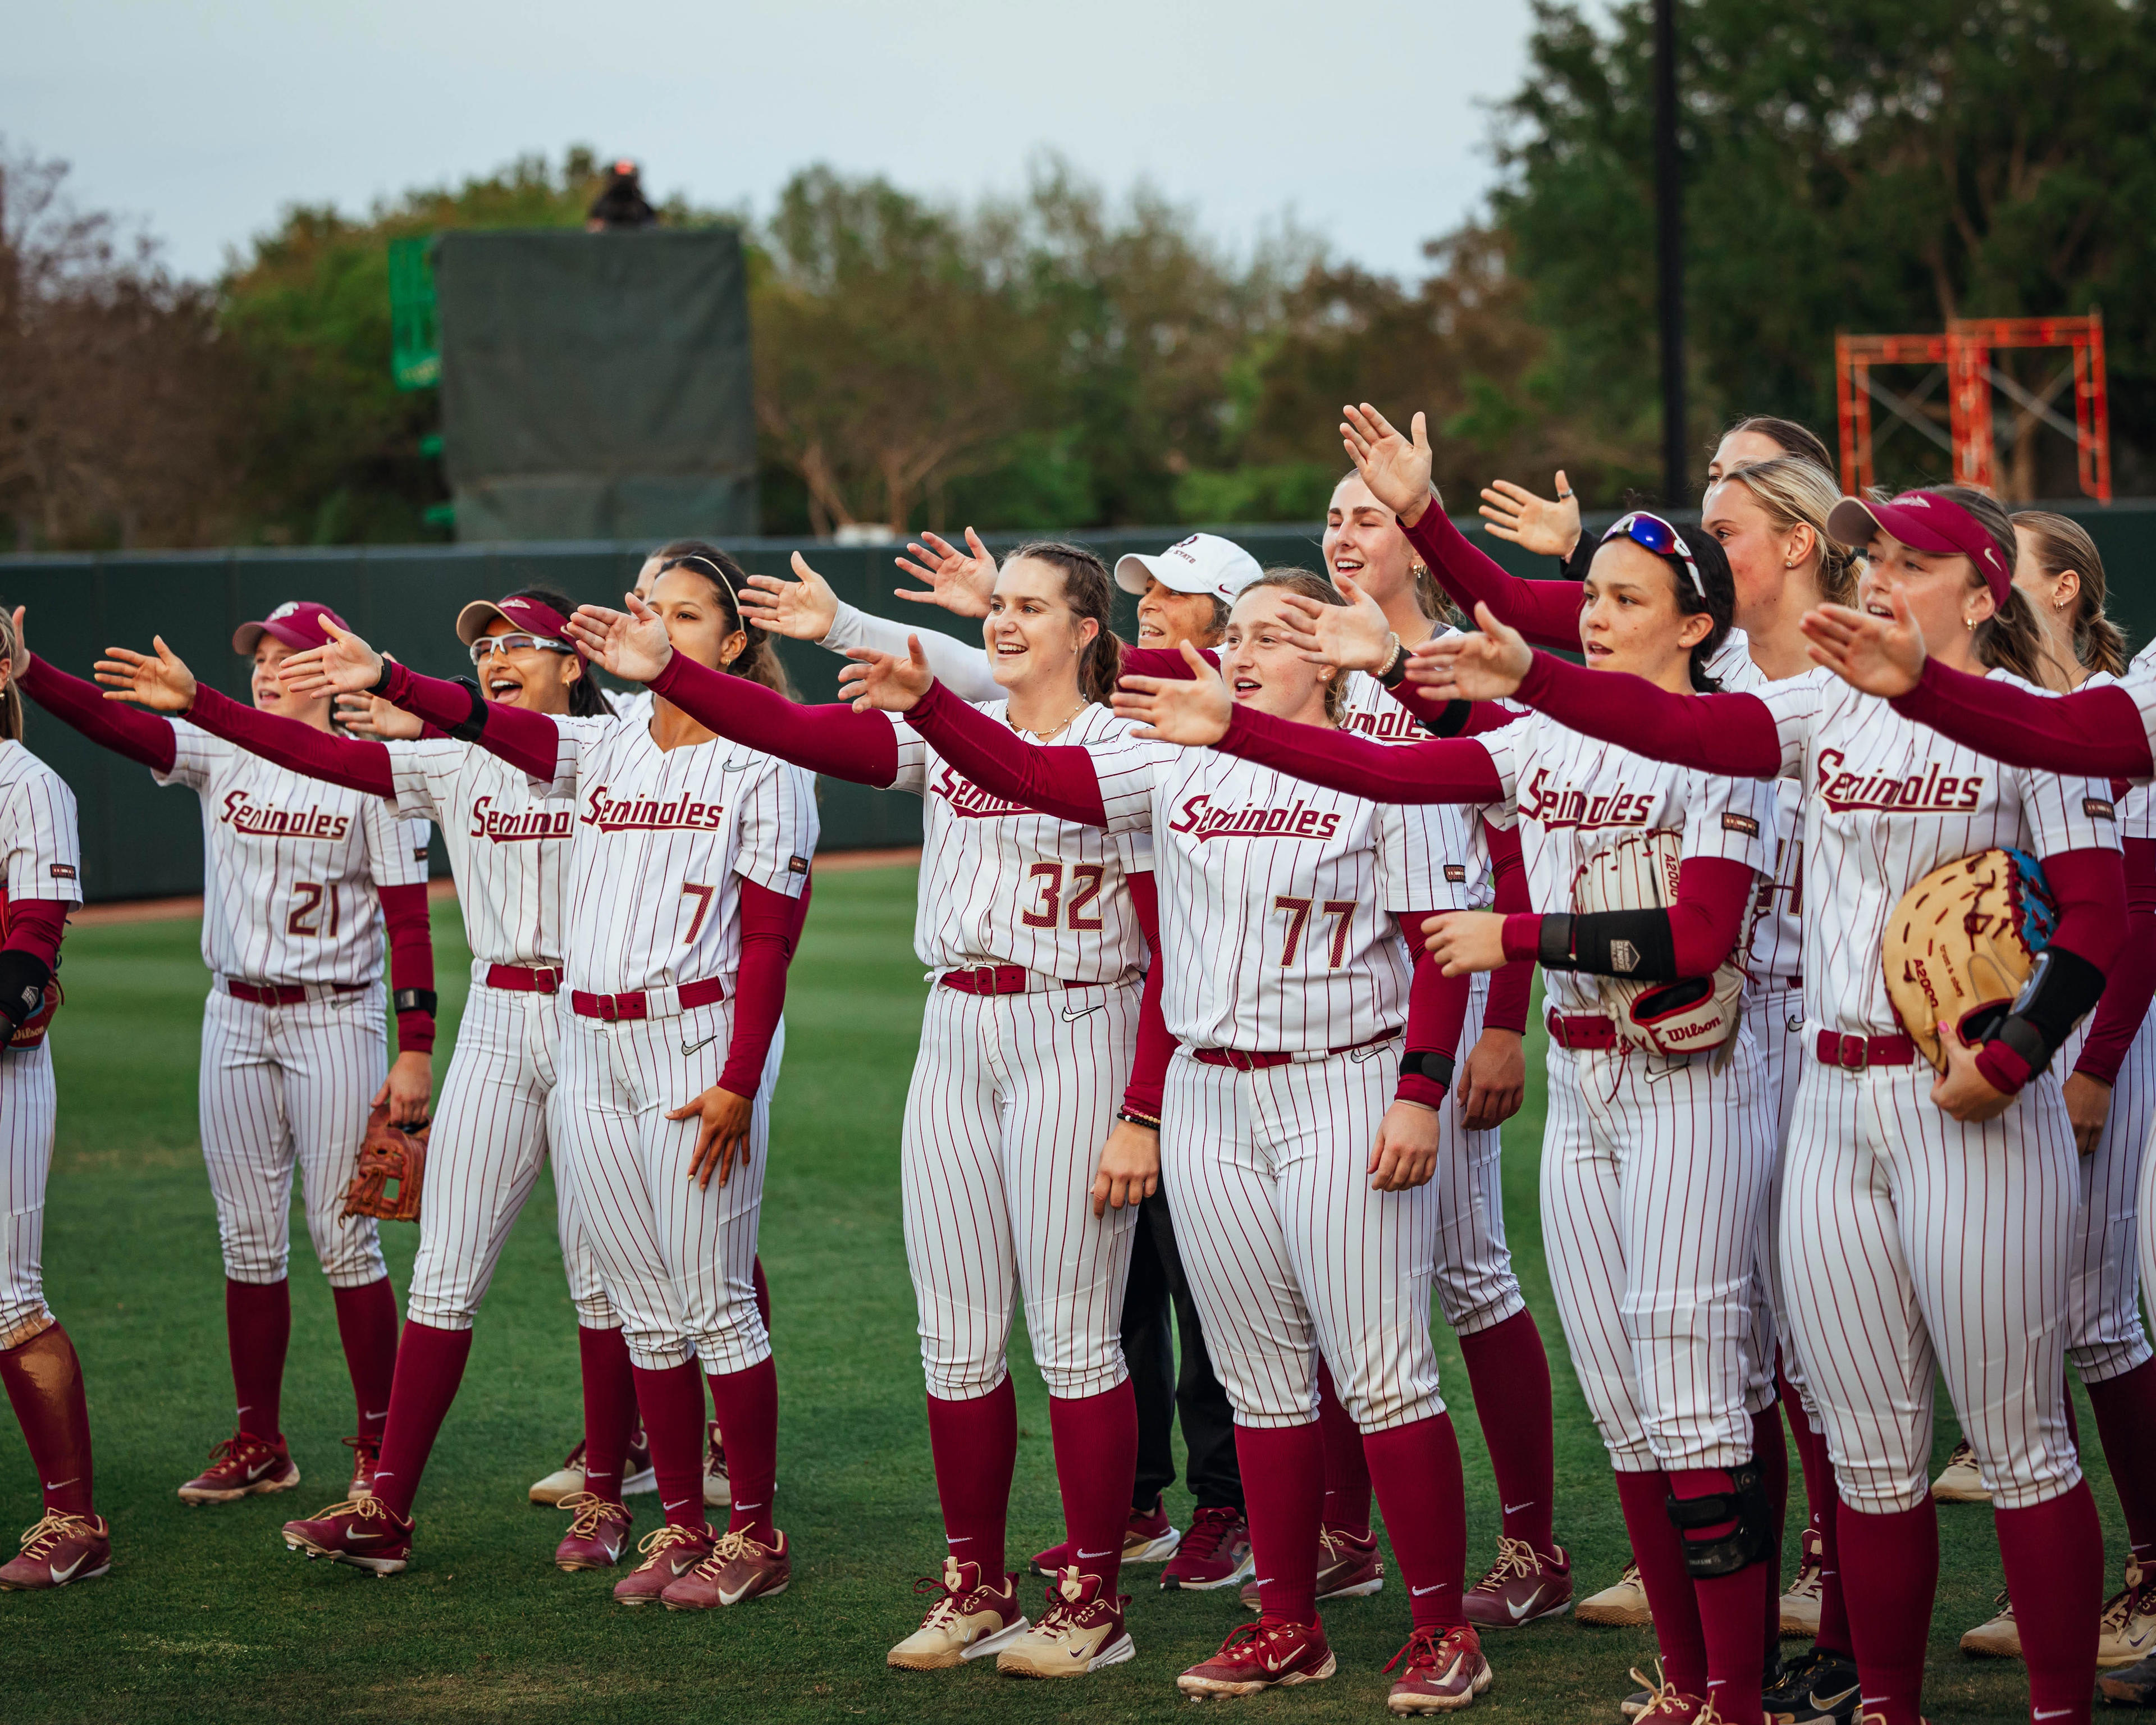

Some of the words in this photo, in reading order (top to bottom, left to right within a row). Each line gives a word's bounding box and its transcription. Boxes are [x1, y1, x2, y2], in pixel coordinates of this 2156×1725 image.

[1173, 550, 1196, 564] STATE
[286, 882, 340, 939] 21
[680, 880, 717, 946] 7
[1021, 861, 1107, 933] 32
[1272, 895, 1360, 971] 77
[1665, 1016, 1721, 1042] Wilson
